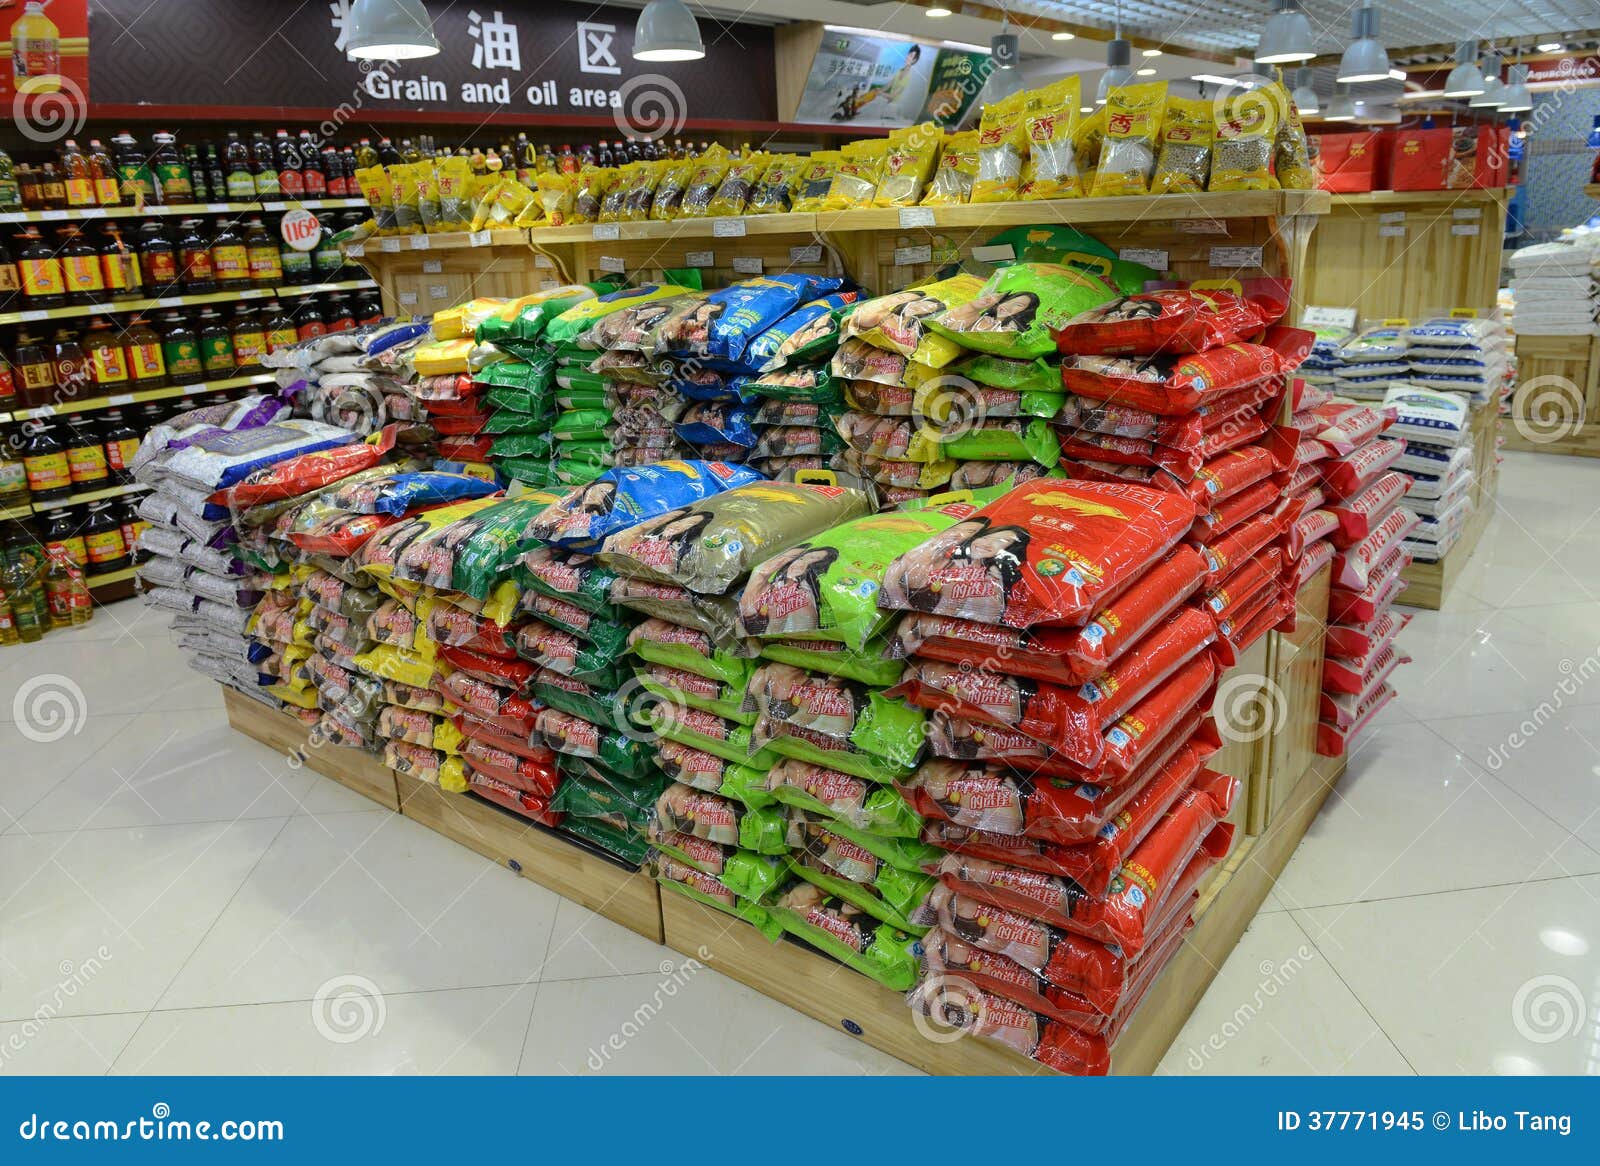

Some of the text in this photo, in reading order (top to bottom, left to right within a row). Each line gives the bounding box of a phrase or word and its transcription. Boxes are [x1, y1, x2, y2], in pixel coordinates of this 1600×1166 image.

[366, 69, 623, 108] Grain and oil area
